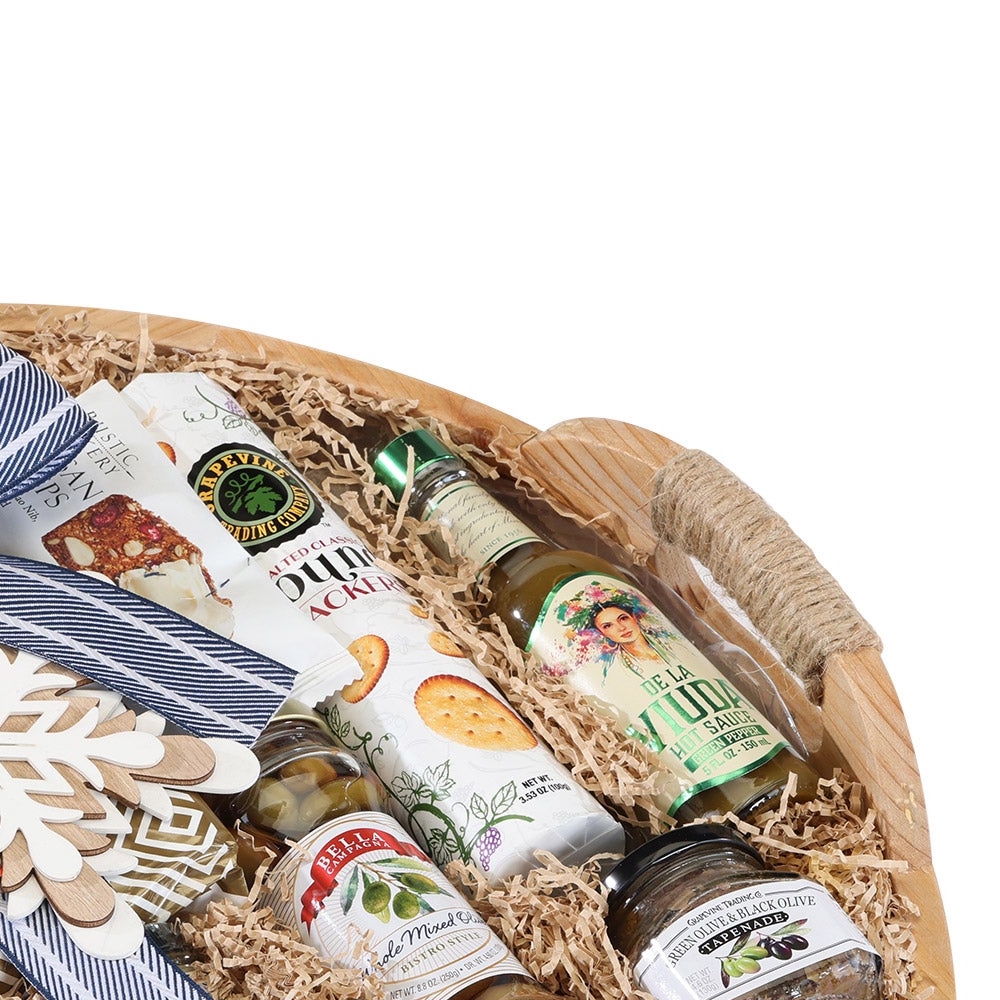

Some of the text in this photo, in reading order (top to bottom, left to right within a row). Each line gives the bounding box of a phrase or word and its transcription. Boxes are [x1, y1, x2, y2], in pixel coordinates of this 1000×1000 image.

[279, 484, 311, 528] COMPANY
[640, 665, 696, 697] DE LA
[626, 678, 756, 754] VIUDA
[669, 710, 757, 760] HOT SAUCE
[692, 725, 762, 763] GREEN PEPPER
[723, 739, 759, 761] OZ 150
[518, 781, 572, 805] 3.53 OZ (100g)
[521, 777, 538, 789] NET
[316, 831, 386, 870] BELLA
[326, 840, 392, 876] CAMPAGNA
[687, 891, 755, 928] GRAPEVINE TRADING
[694, 915, 730, 940] OLIVE
[736, 900, 779, 918] BLACK
[777, 895, 816, 909] OLIVE
[401, 913, 457, 945] Mixed
[702, 913, 785, 953] TAPENADE
[400, 932, 482, 974] BISTRO STYLE
[440, 968, 461, 984] (250g)
